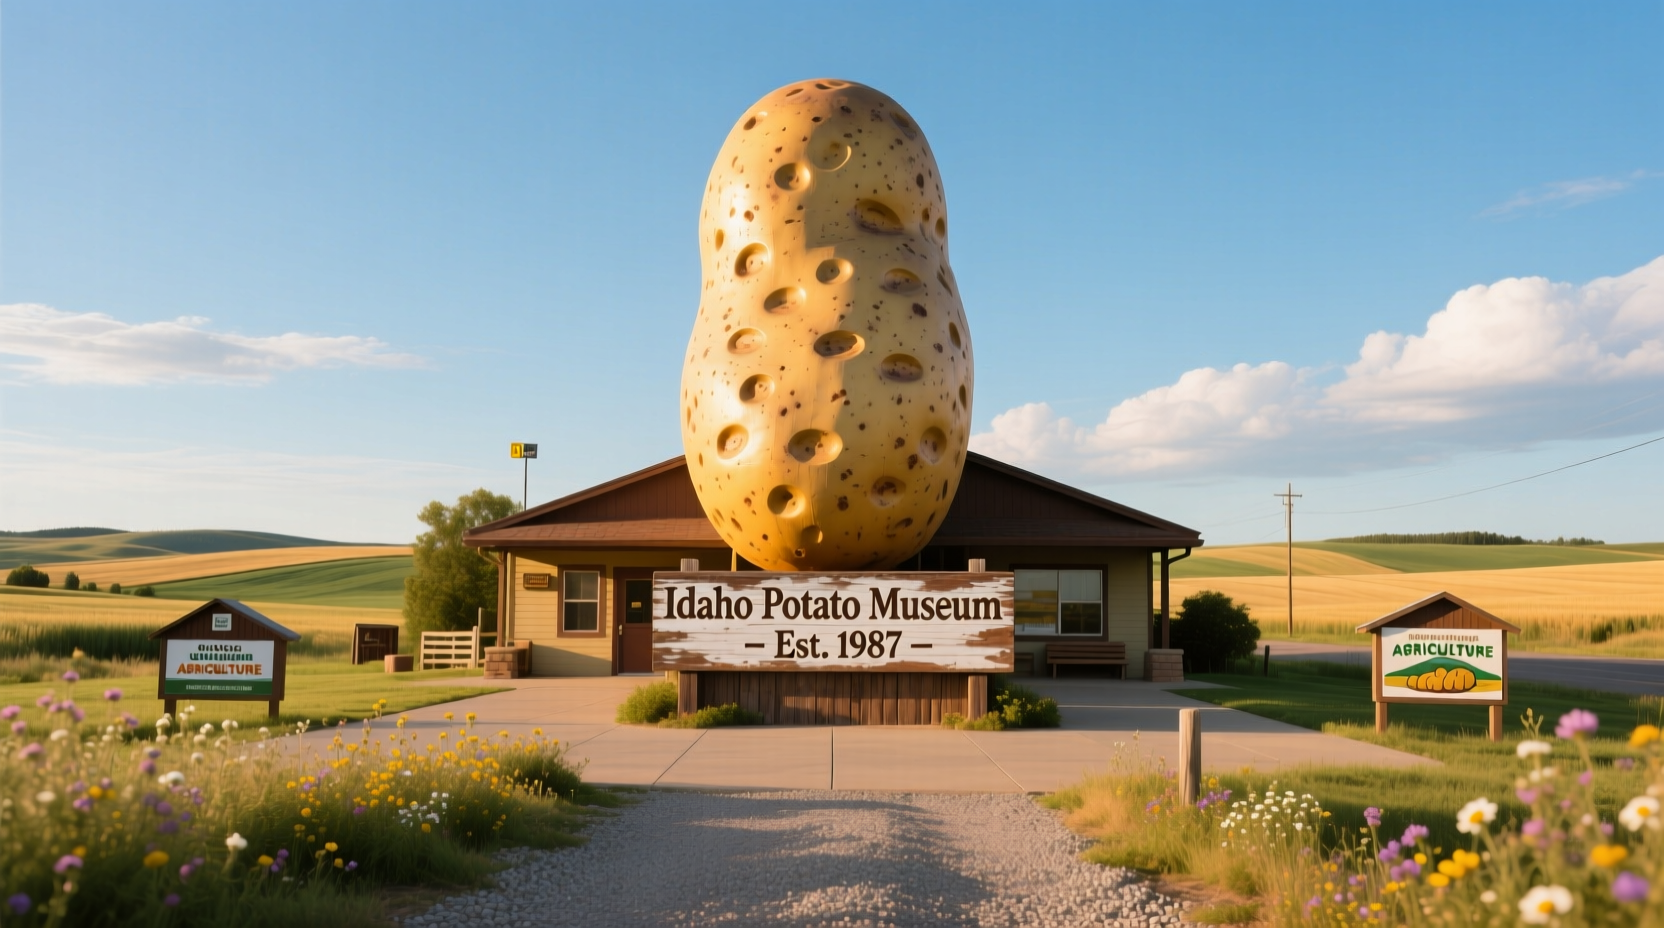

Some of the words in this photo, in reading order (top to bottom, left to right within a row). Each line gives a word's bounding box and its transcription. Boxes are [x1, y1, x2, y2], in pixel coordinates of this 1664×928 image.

[664, 586, 753, 620] Idaho
[761, 587, 861, 620] Potato
[869, 587, 1003, 621] Museum
[774, 630, 829, 659] Est.
[837, 630, 903, 659] 1987
[1392, 643, 1493, 658] AGRICULTURE
